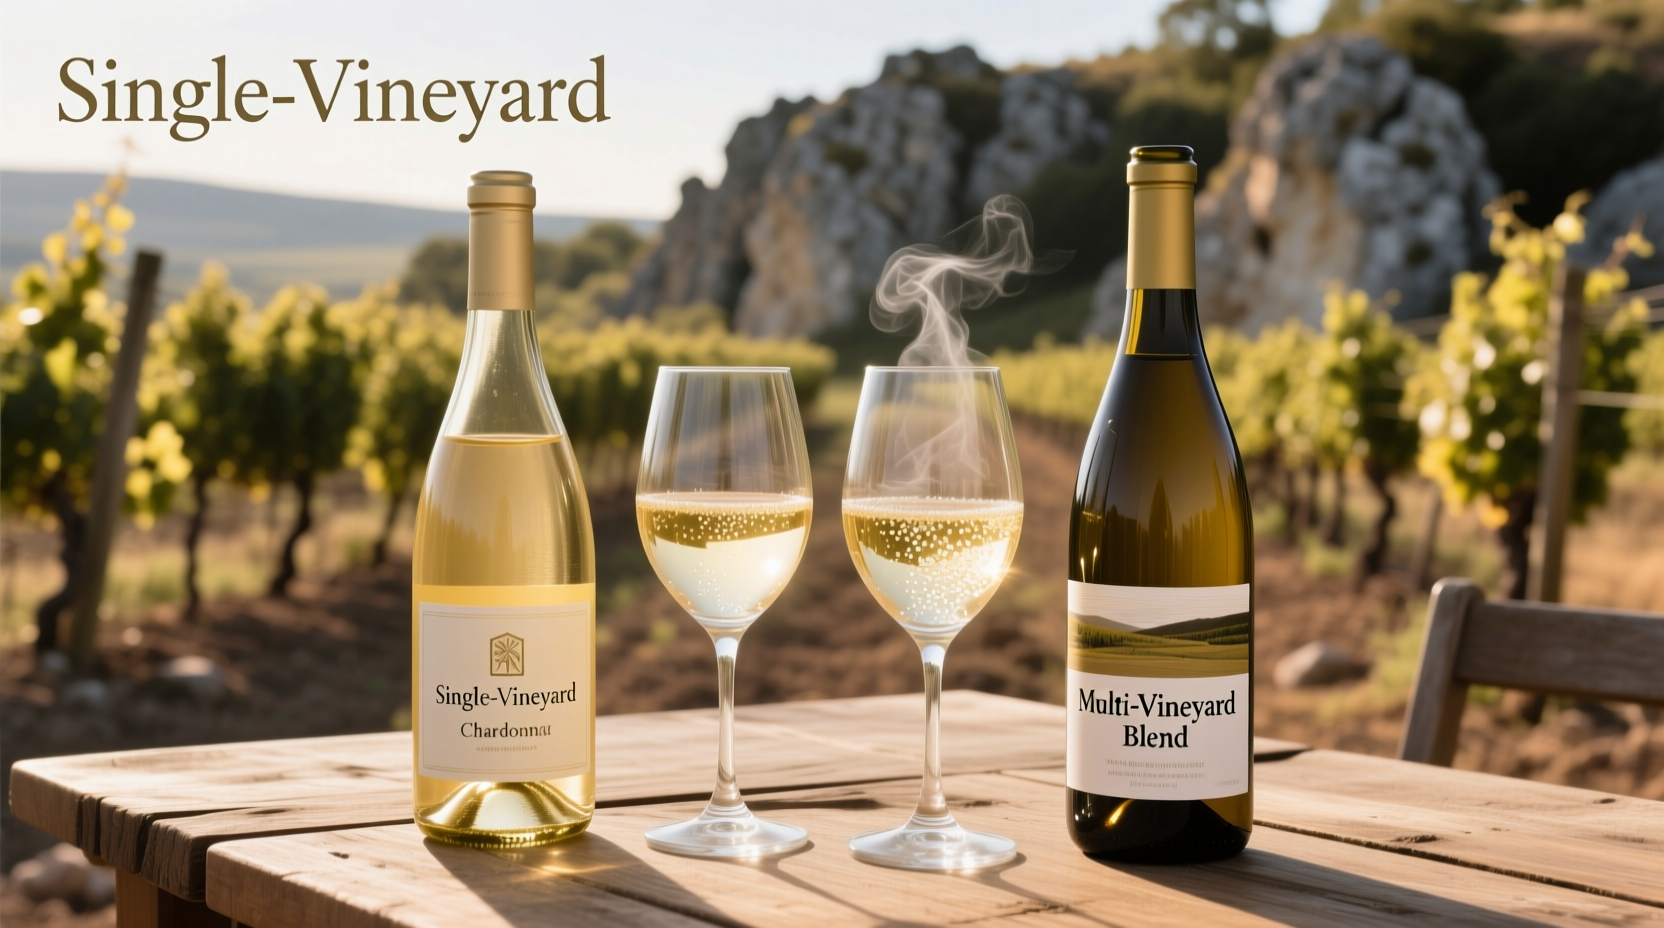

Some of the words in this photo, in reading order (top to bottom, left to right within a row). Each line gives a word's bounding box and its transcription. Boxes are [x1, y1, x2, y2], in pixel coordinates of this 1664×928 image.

[435, 681, 577, 712] Single-Vineyard
[1078, 687, 1236, 724] Multi-Vineyard
[1122, 723, 1189, 749] Blend
